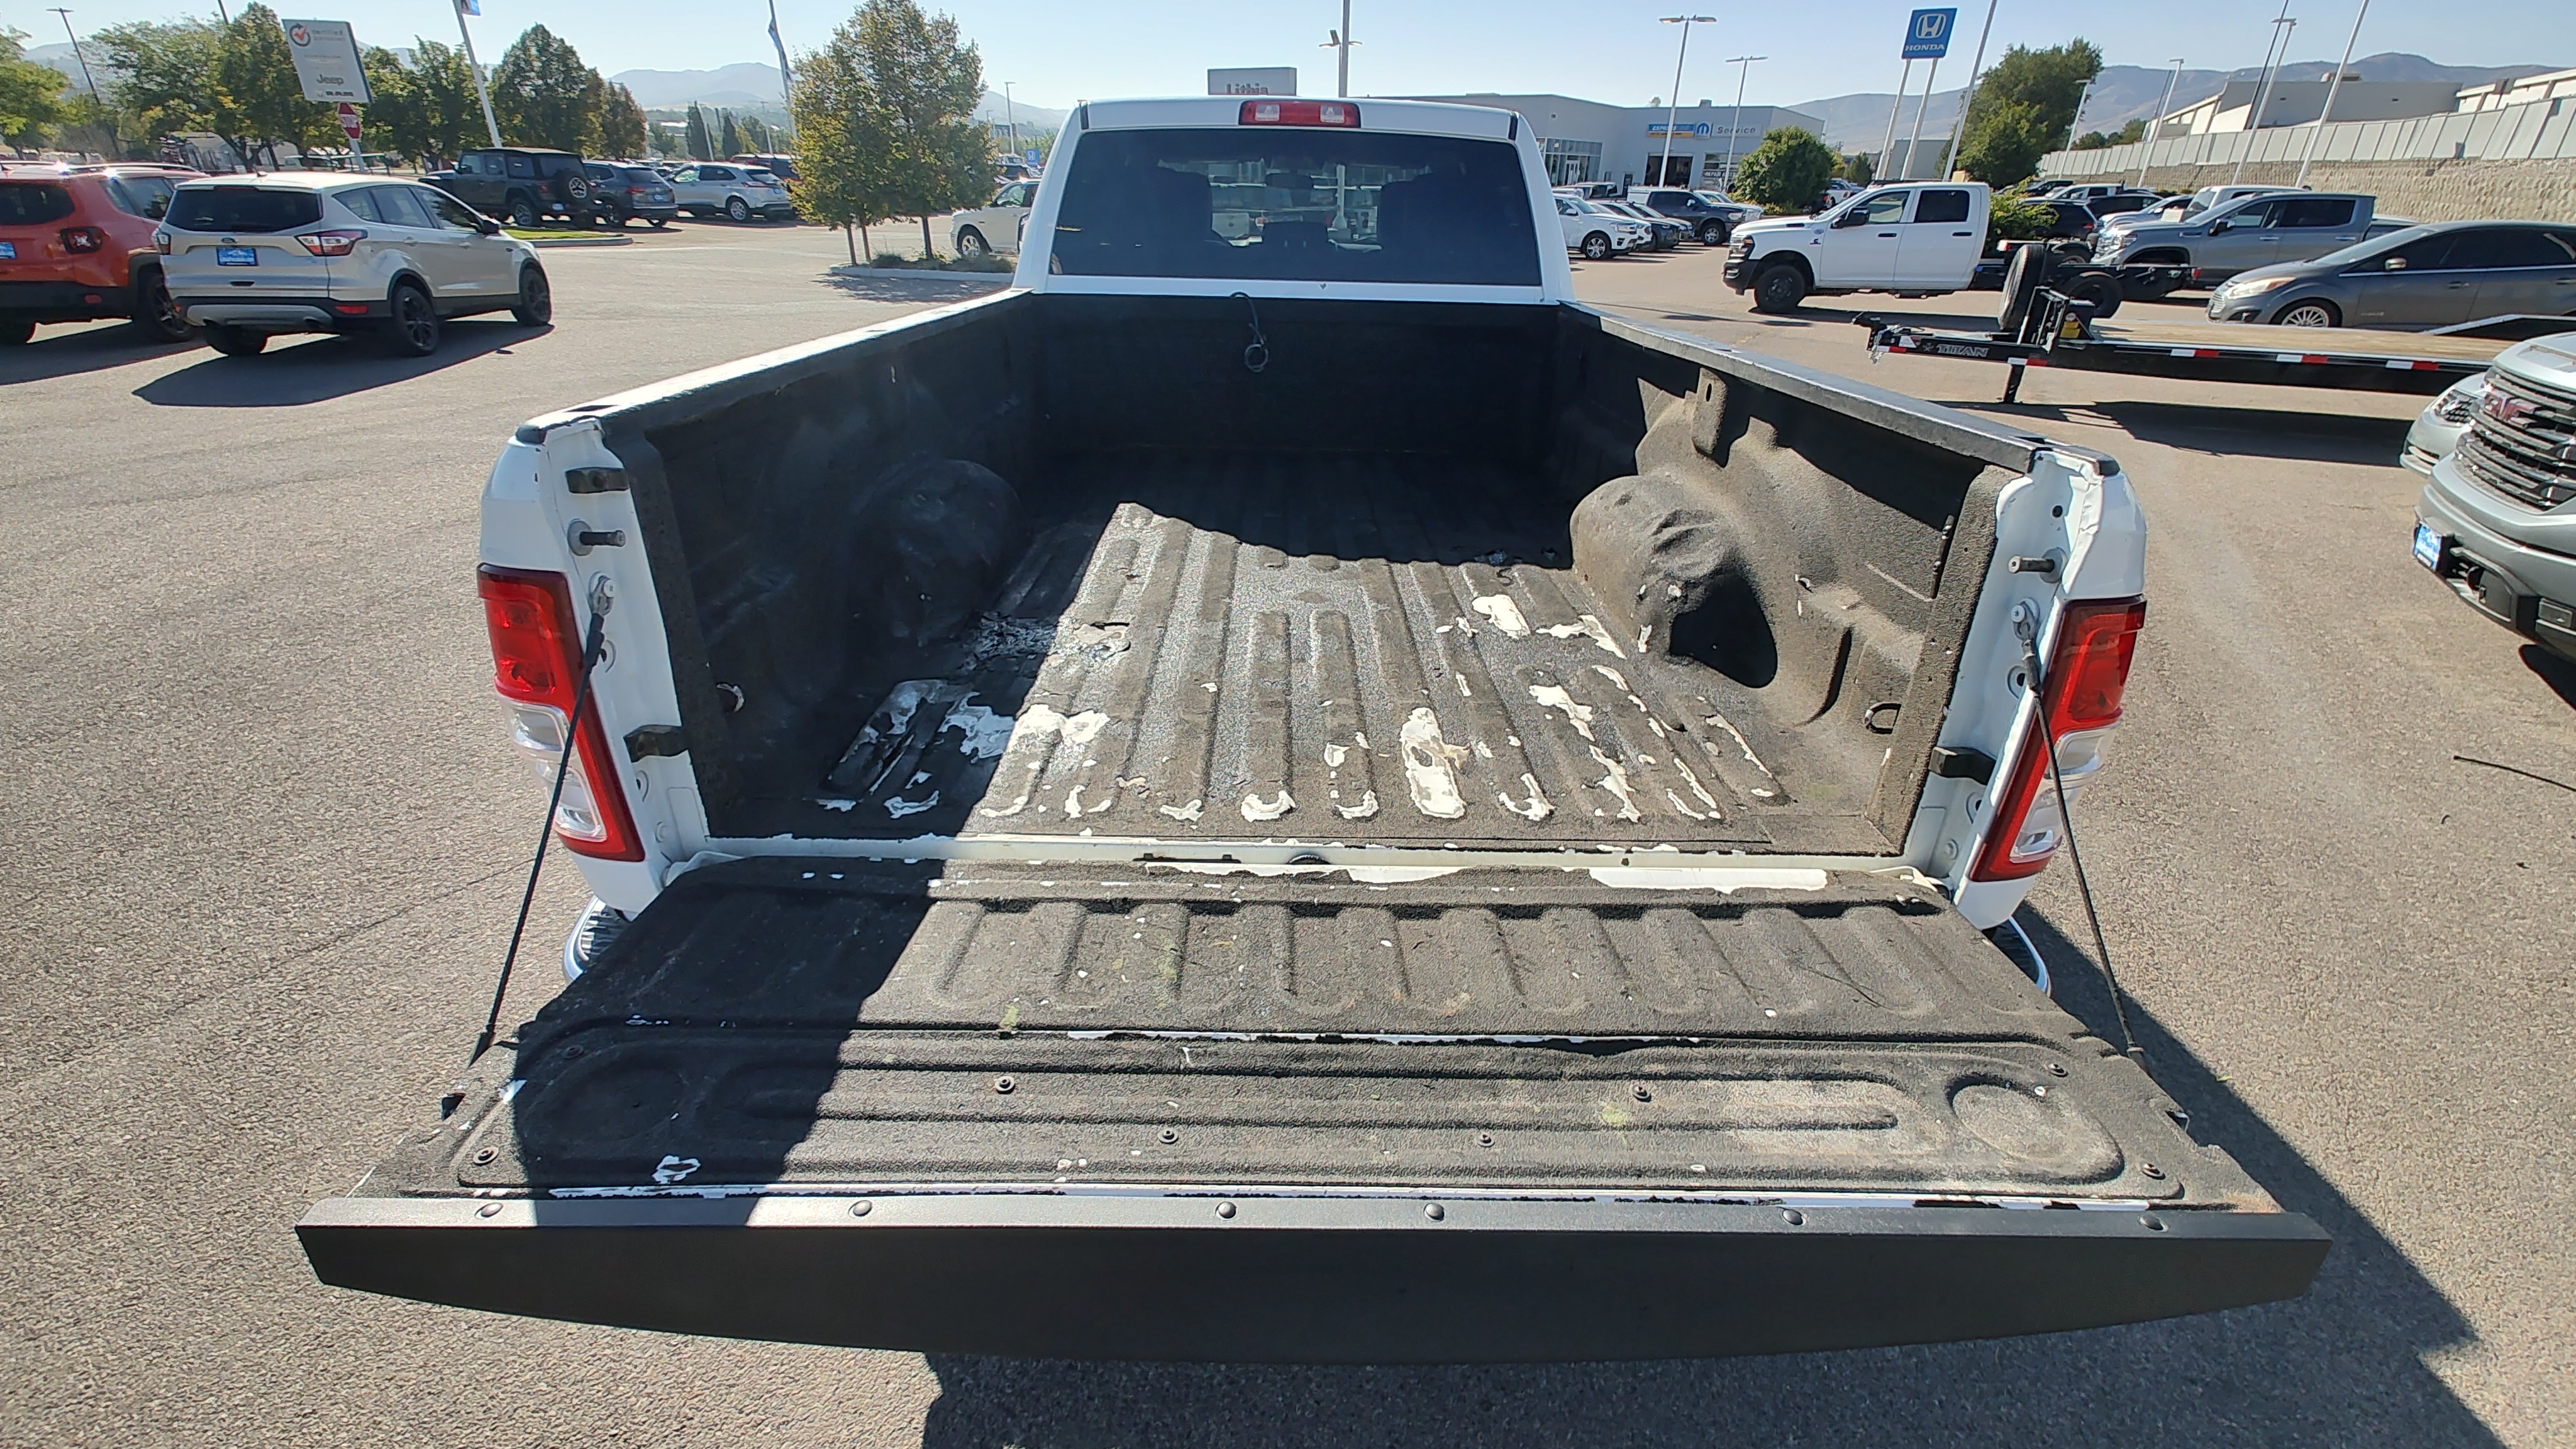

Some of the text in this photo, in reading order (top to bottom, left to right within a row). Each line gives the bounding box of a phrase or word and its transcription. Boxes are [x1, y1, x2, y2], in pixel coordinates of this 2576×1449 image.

[316, 74, 344, 86] Jeep
[1226, 83, 1268, 94] Lithia
[1936, 343, 1989, 357] TITAN
